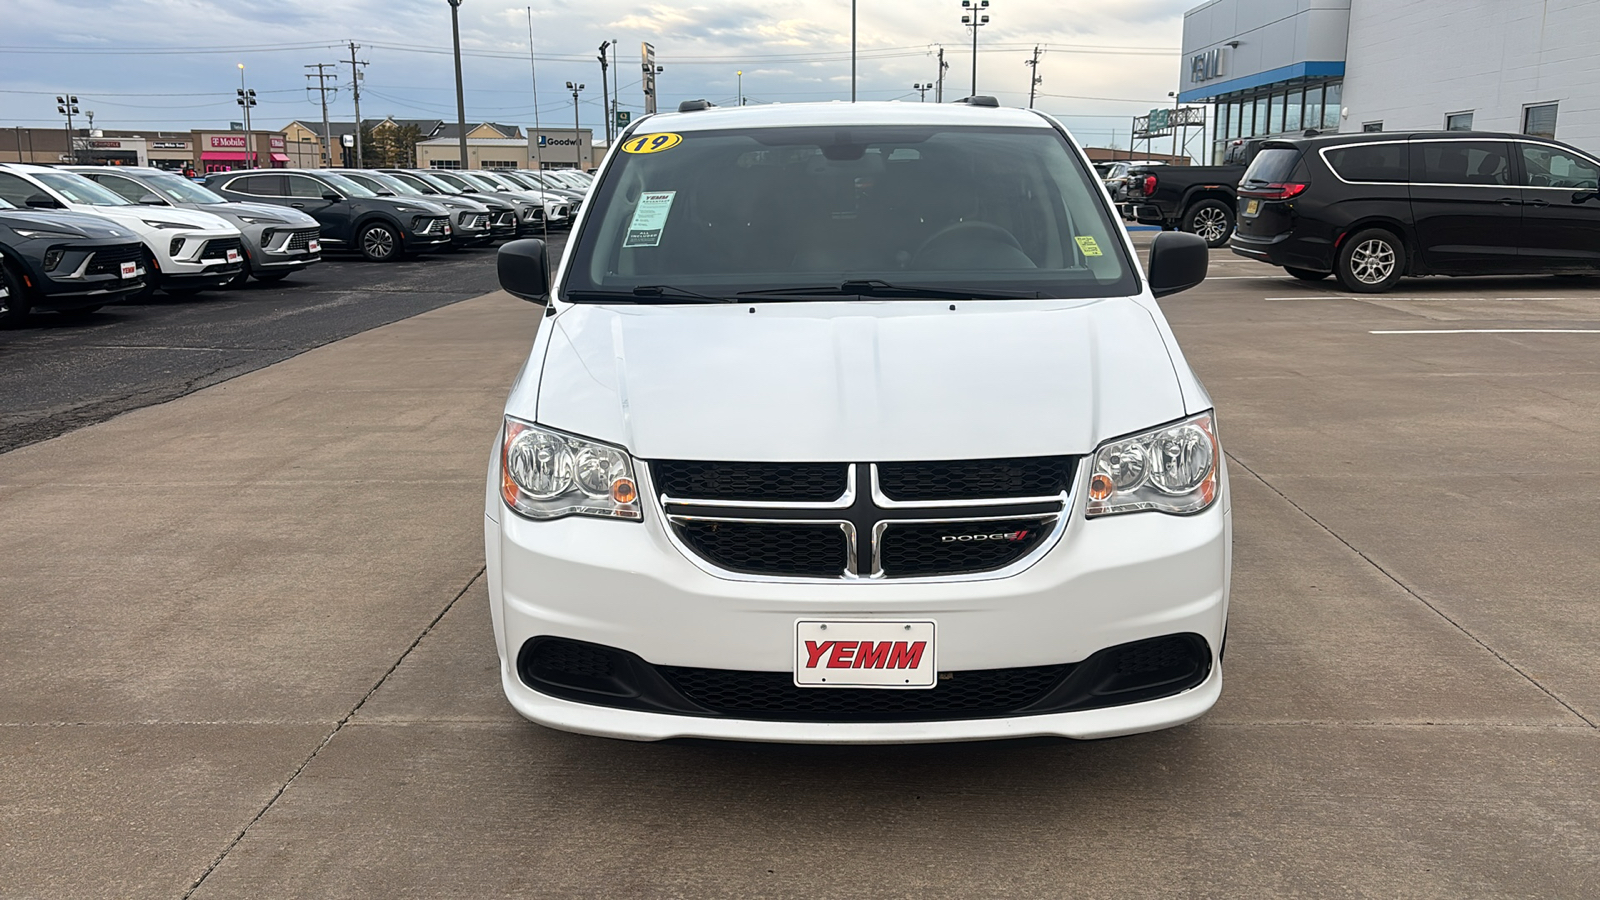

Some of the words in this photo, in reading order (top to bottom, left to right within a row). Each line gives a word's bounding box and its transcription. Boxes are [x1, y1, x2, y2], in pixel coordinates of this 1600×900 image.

[220, 136, 245, 146] Mobile
[547, 138, 582, 146] Goodwl
[634, 135, 669, 151] 19
[941, 533, 1017, 542] DODGE
[805, 641, 927, 669] YEMM
